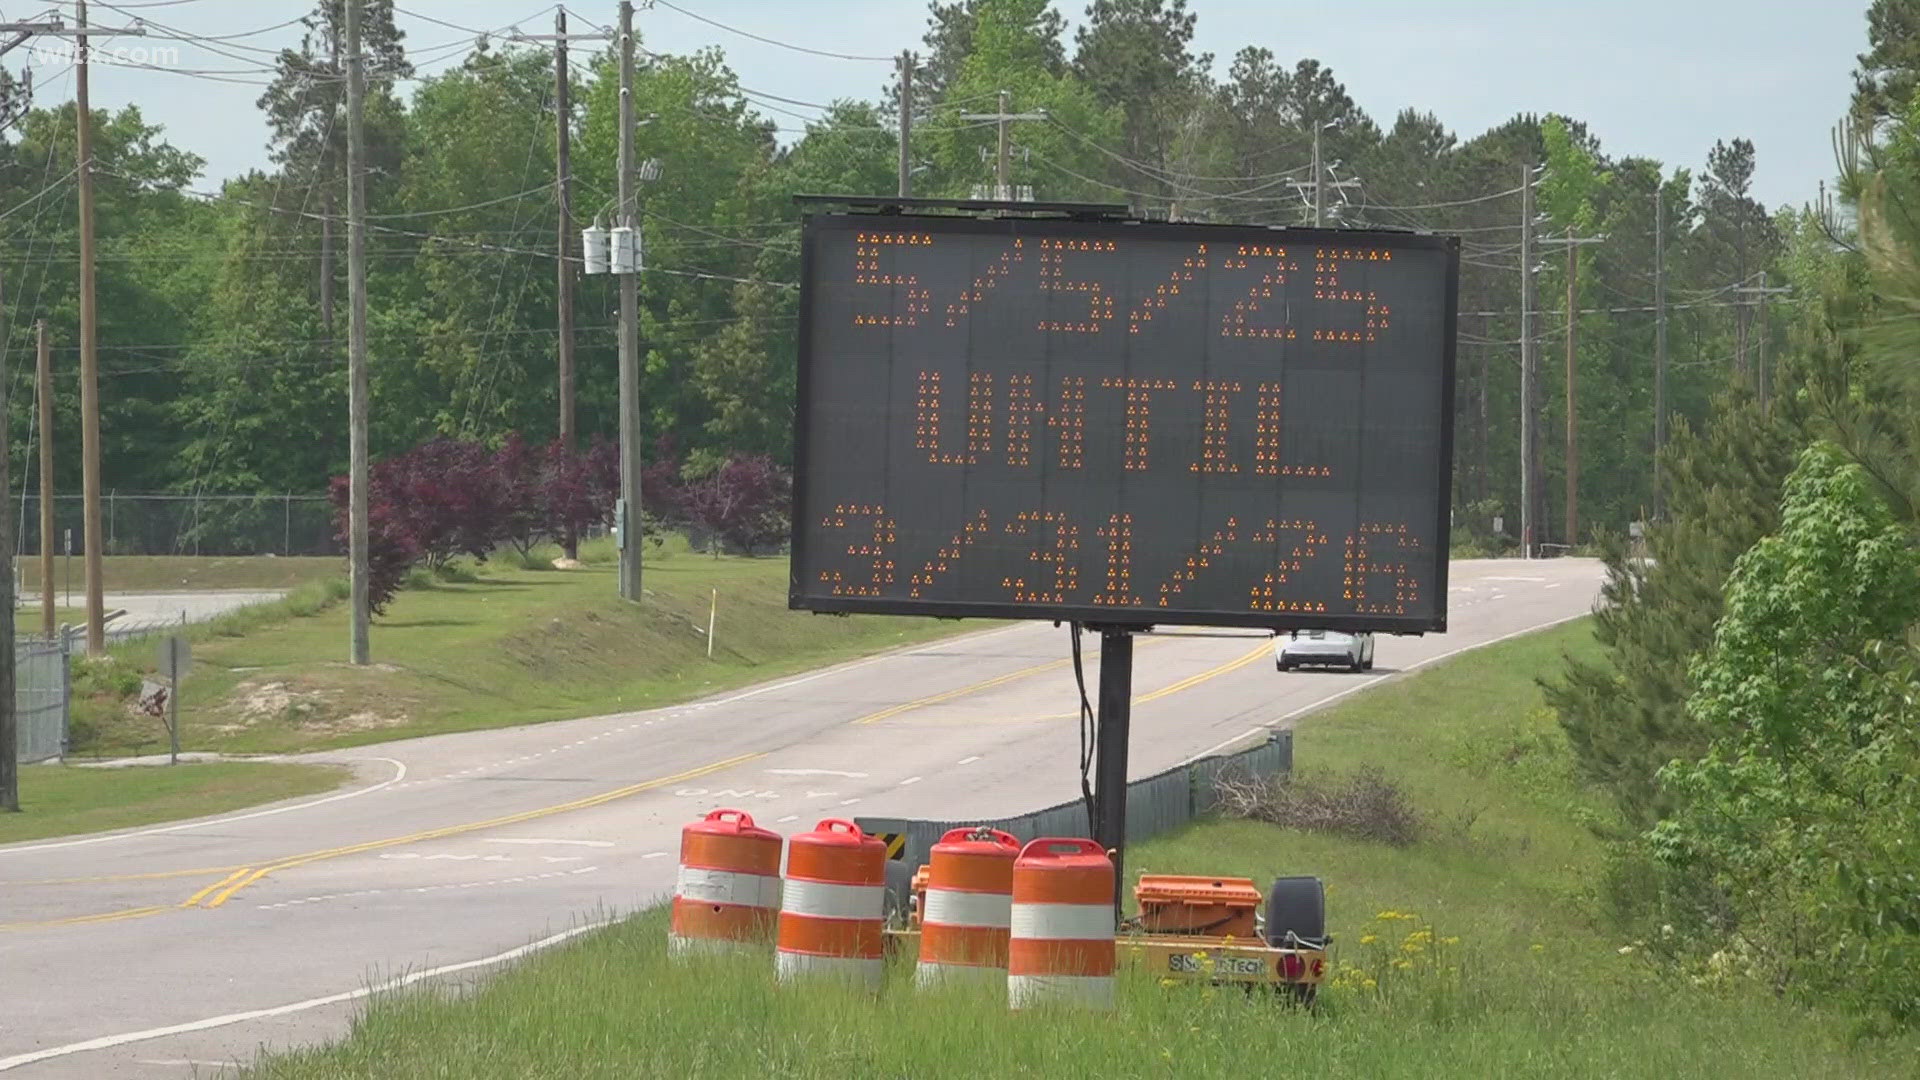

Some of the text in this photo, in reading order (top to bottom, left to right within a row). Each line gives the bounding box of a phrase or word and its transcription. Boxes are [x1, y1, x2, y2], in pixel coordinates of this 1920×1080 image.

[855, 232, 1392, 342] 5/5/25
[916, 371, 1331, 477] UNTIL
[819, 503, 1420, 615] 3/31/26
